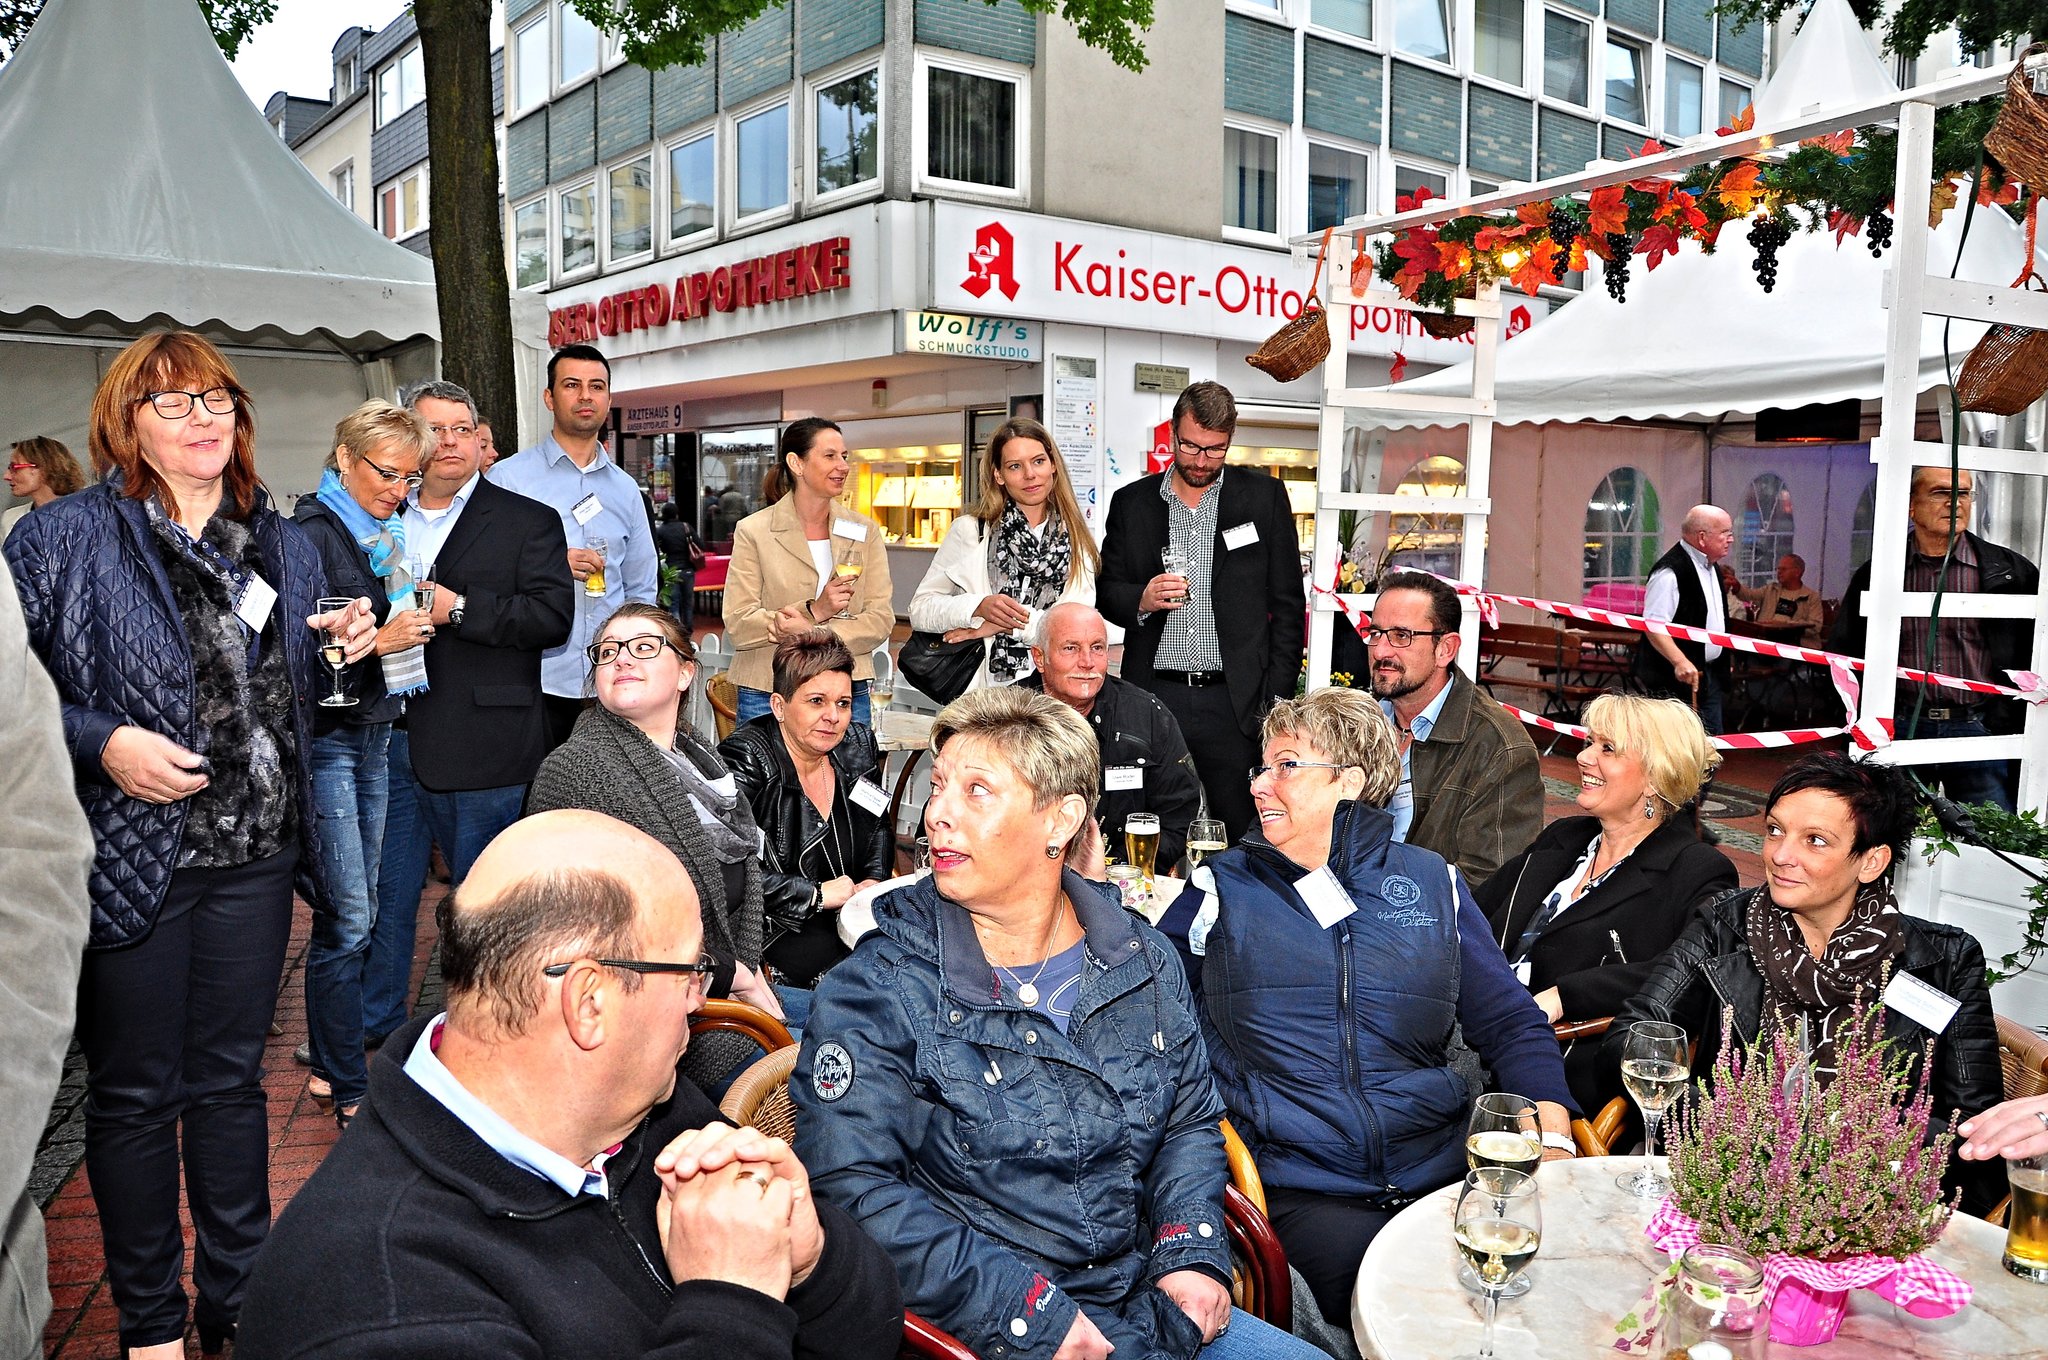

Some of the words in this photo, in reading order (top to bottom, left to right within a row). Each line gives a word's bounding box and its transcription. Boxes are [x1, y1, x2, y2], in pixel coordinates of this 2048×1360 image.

[598, 284, 671, 337] OTTO
[672, 236, 851, 321] APOTHEKE
[918, 313, 1028, 341] Wolff's
[918, 340, 1030, 358] SCHMUCKSTUDIO
[674, 404, 682, 427] 9
